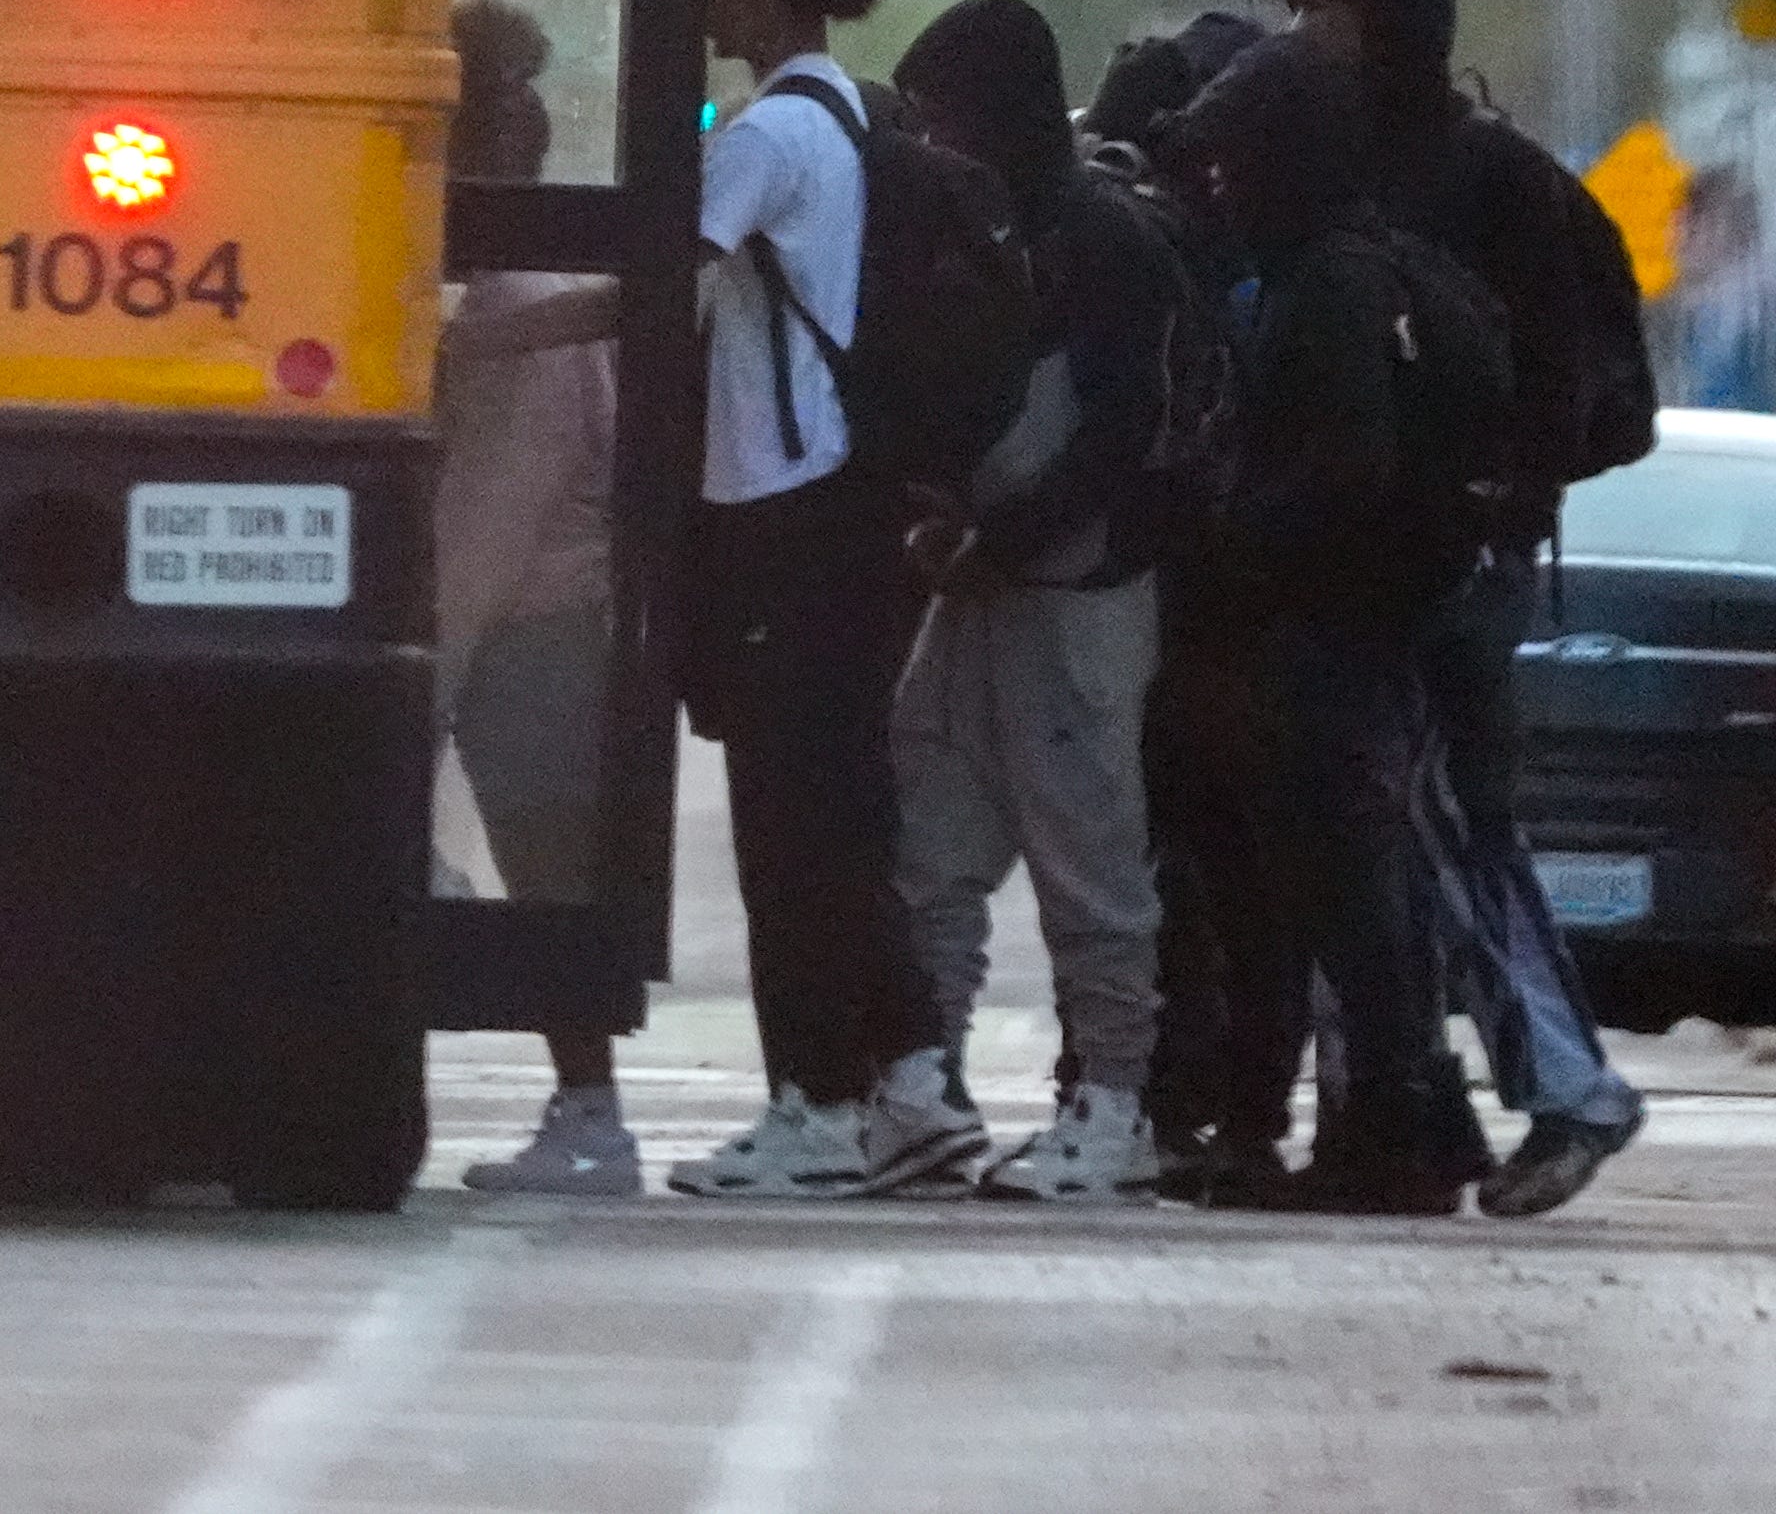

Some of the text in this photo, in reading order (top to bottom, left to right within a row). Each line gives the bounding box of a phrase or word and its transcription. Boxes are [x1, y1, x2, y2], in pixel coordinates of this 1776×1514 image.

[143, 505, 334, 538] RIGHT TURN ON
[143, 550, 334, 584] RED PROHIBITED
